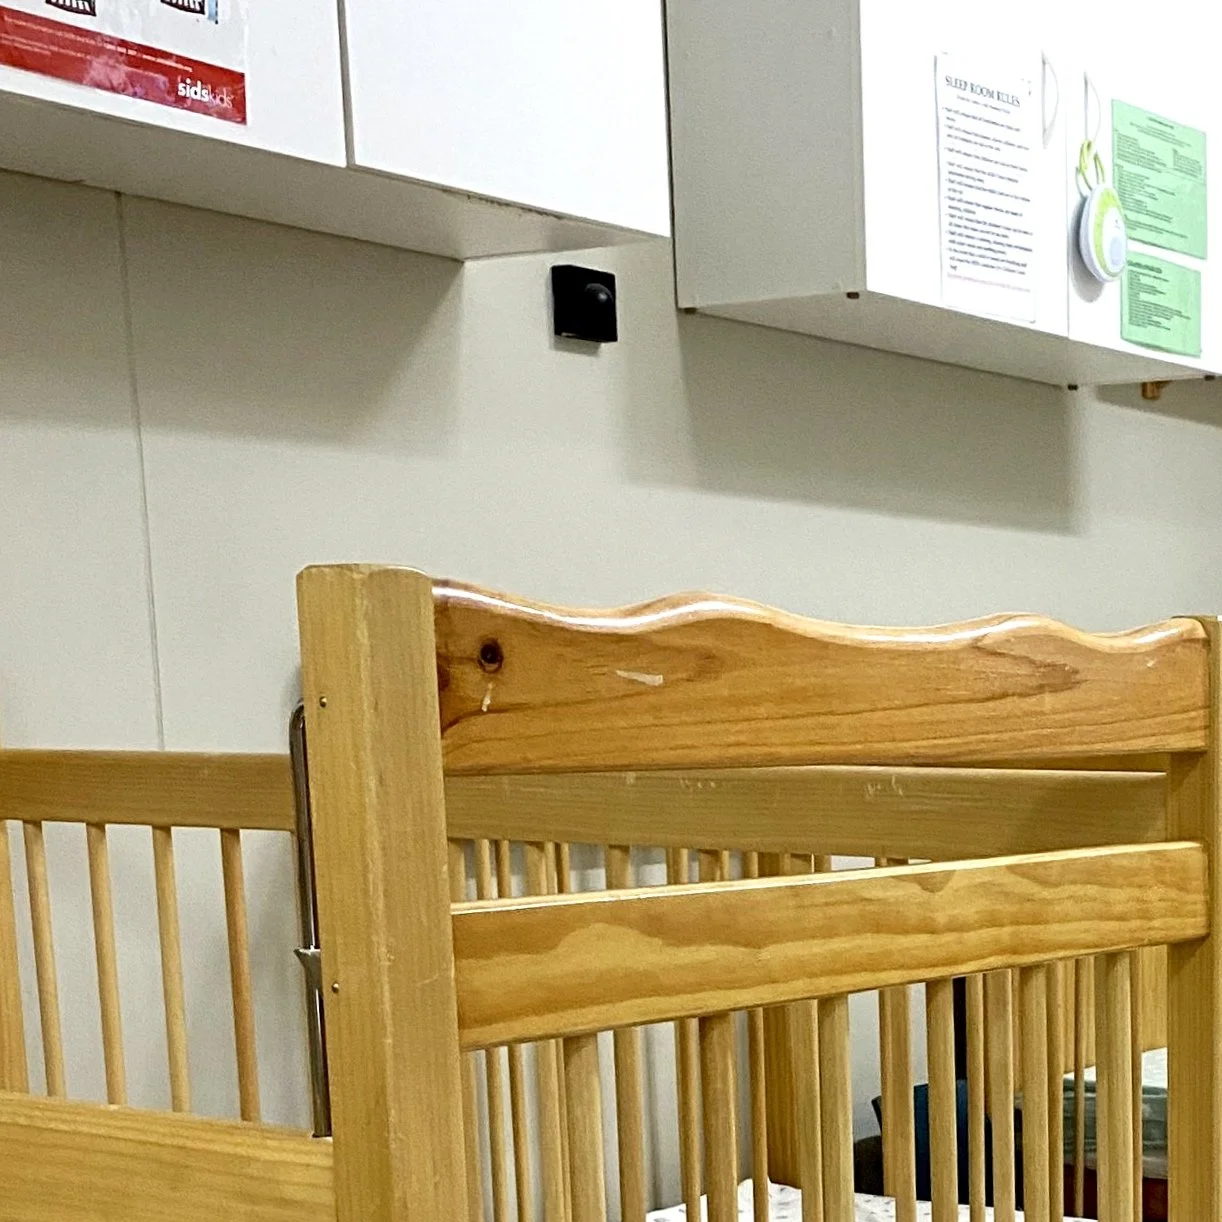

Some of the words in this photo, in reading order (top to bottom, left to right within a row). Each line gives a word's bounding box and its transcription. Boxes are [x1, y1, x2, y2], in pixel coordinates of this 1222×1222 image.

[945, 75, 968, 91] SLEEP
[970, 82, 994, 100] ROOM
[997, 90, 1021, 108] RULES
